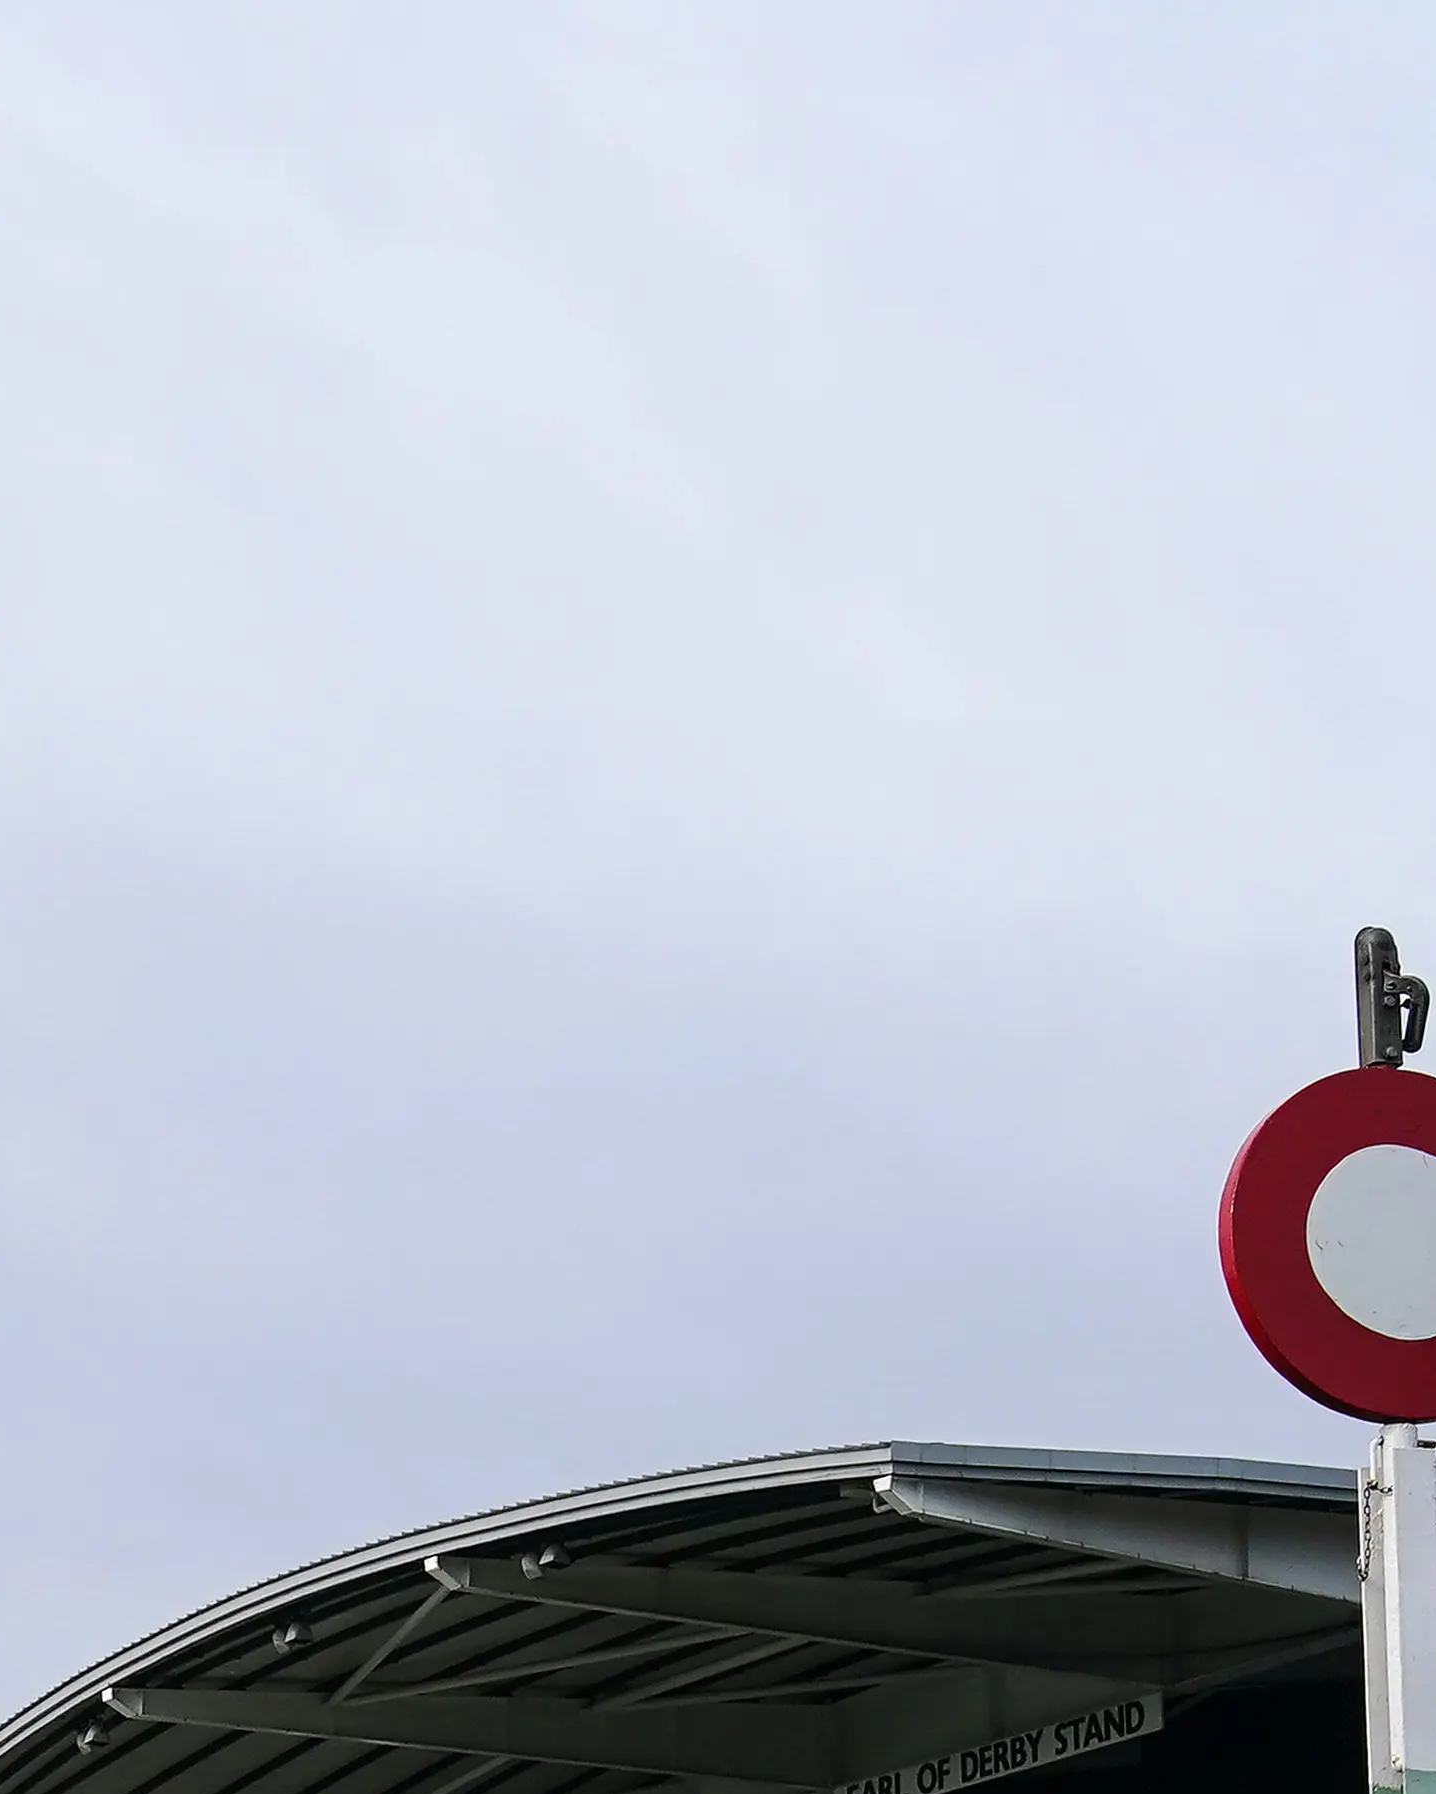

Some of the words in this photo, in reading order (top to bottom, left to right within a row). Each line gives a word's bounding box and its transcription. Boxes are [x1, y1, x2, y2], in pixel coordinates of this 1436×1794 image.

[917, 1757, 951, 1794] OF
[961, 1729, 1045, 1784] DERBY
[1054, 1701, 1145, 1755] STAND
